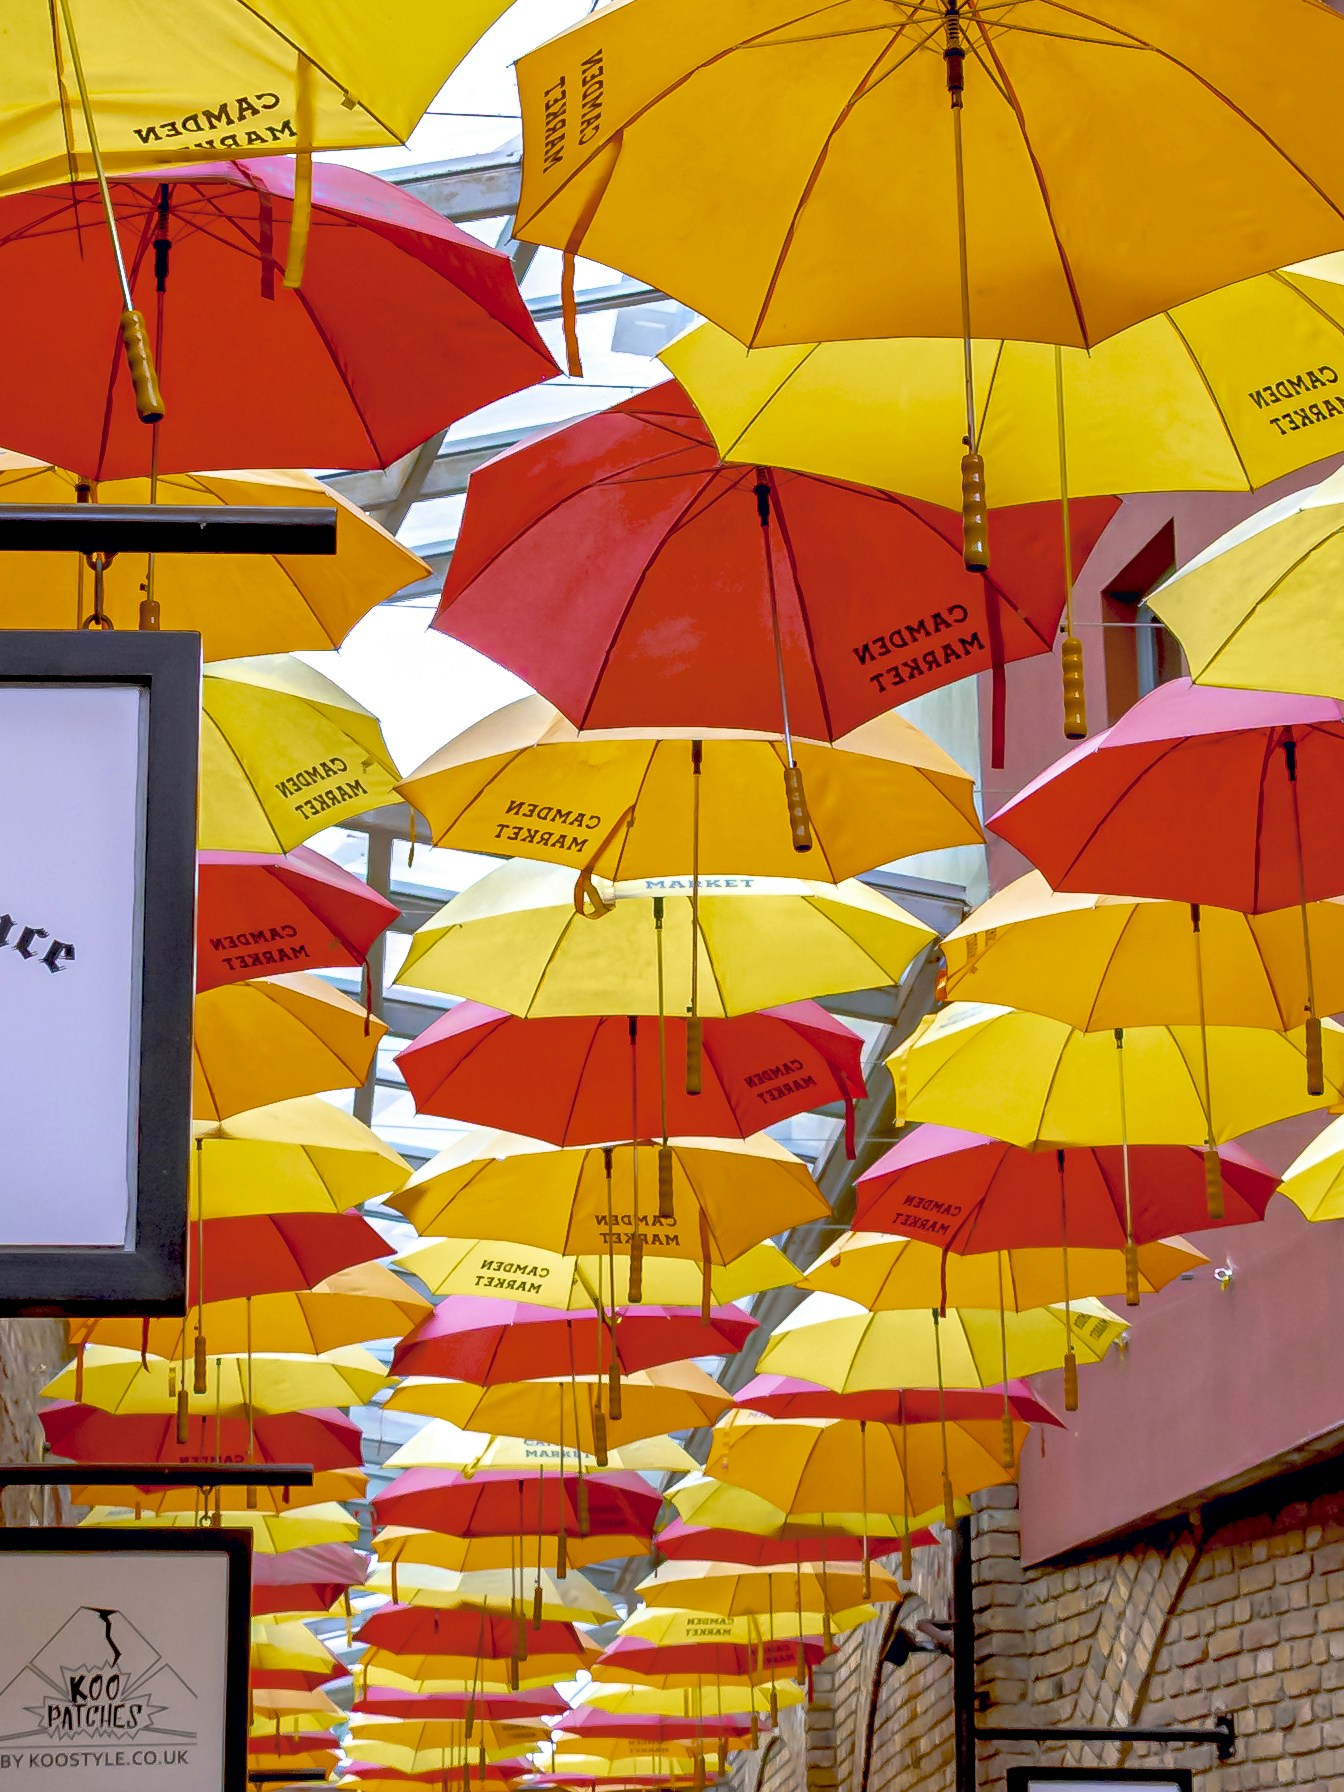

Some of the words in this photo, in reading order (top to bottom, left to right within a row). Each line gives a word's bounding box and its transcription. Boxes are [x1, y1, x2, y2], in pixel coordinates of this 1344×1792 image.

[645, 879, 755, 890] MARKET
[69, 1673, 121, 1703] KOO
[47, 1703, 144, 1731] PATCHES
[0, 1754, 24, 1769] BY
[30, 1750, 189, 1768] KOOSTYLE.CO.UK
